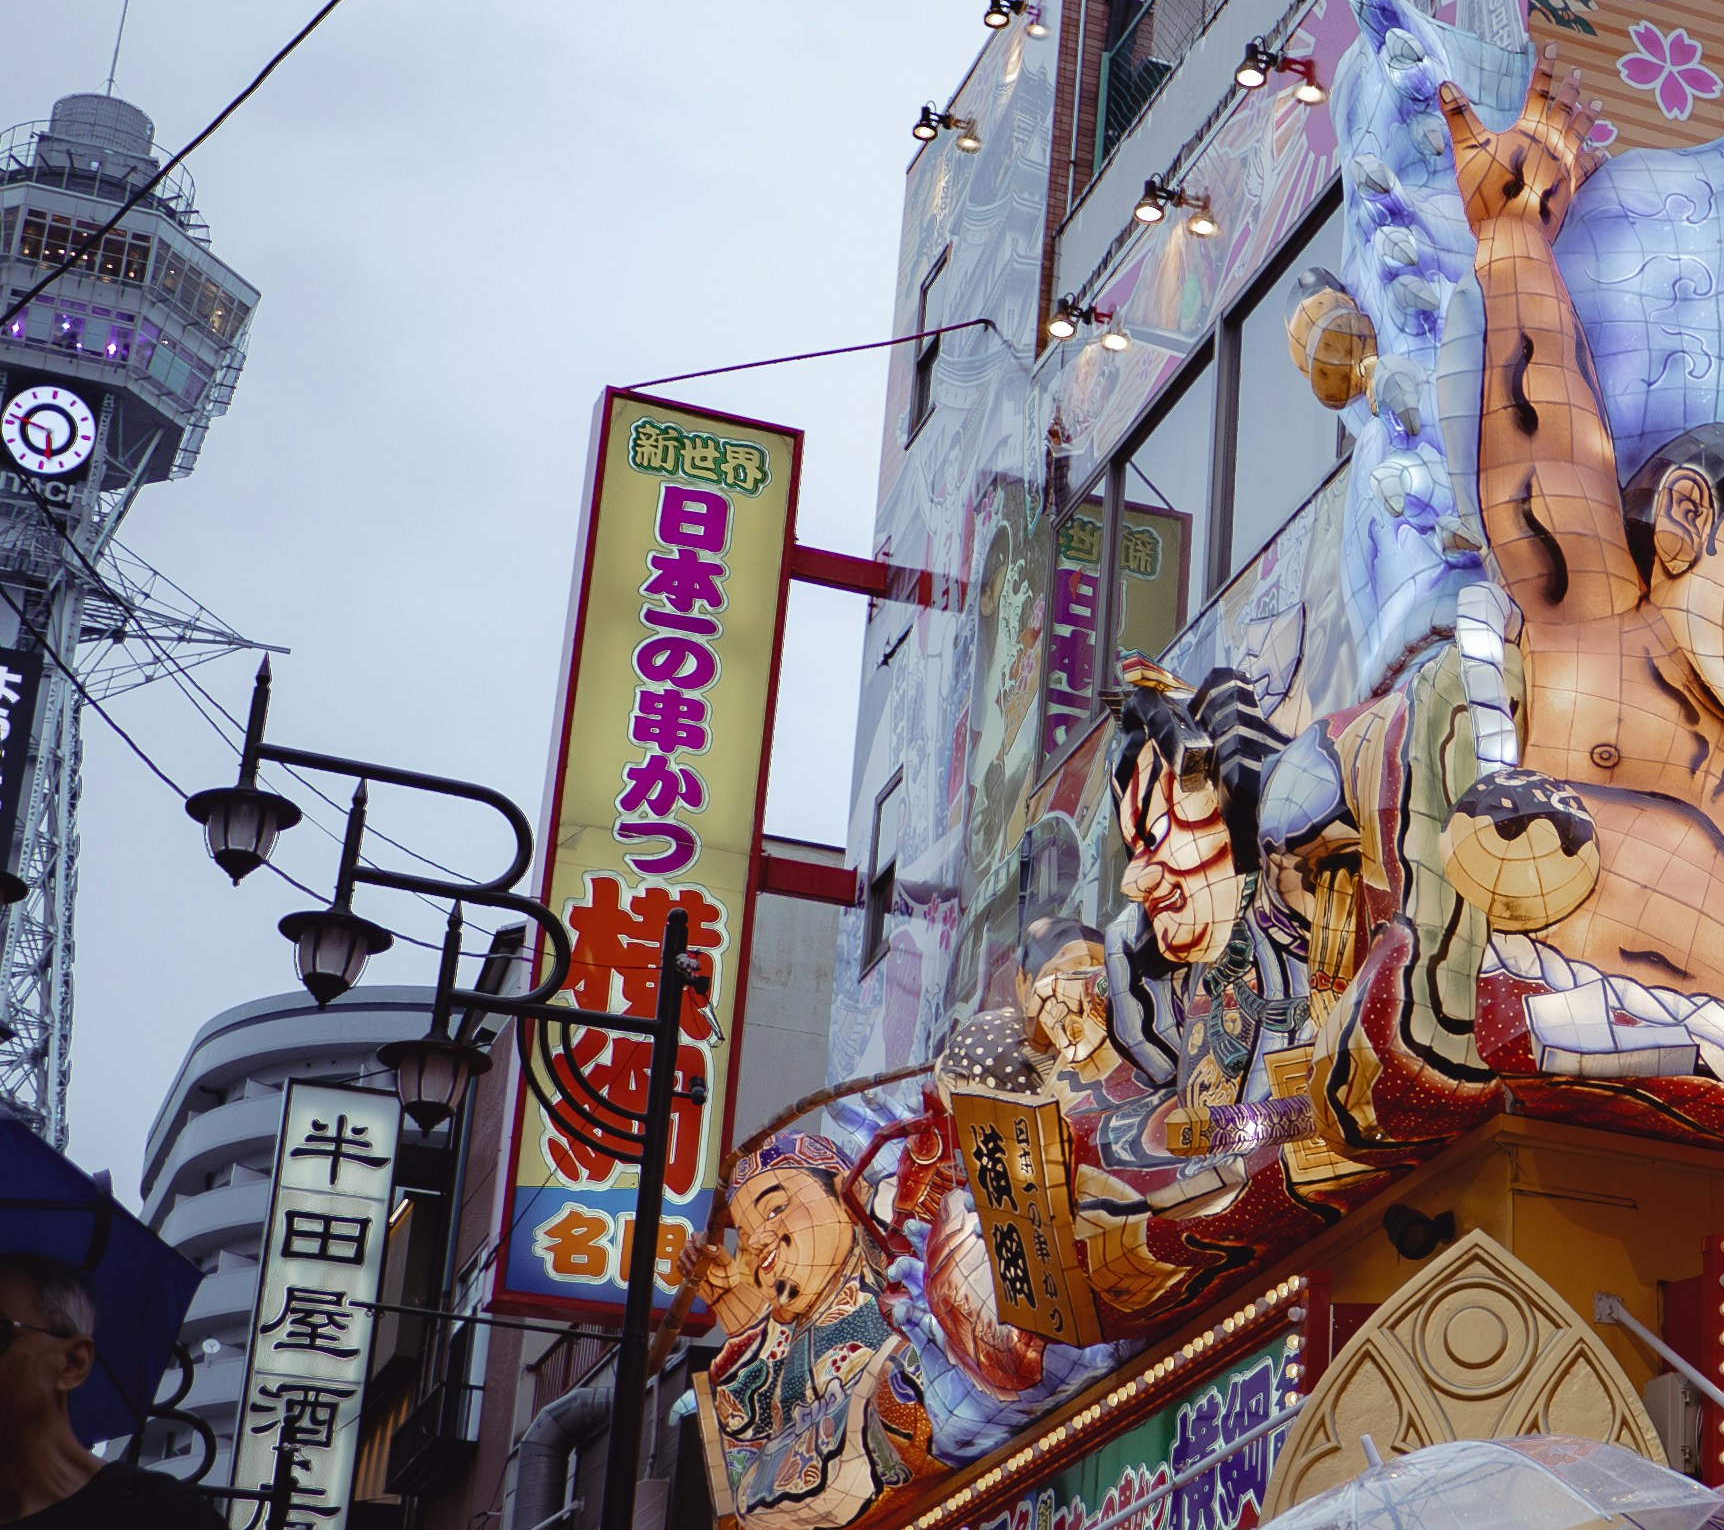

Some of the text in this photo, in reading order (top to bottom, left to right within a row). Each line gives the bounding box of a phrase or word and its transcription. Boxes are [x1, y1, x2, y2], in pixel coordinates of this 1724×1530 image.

[631, 419, 770, 493] 新世界
[617, 485, 729, 875] 日本一の串かつ
[969, 1123, 1038, 1311] 横綱
